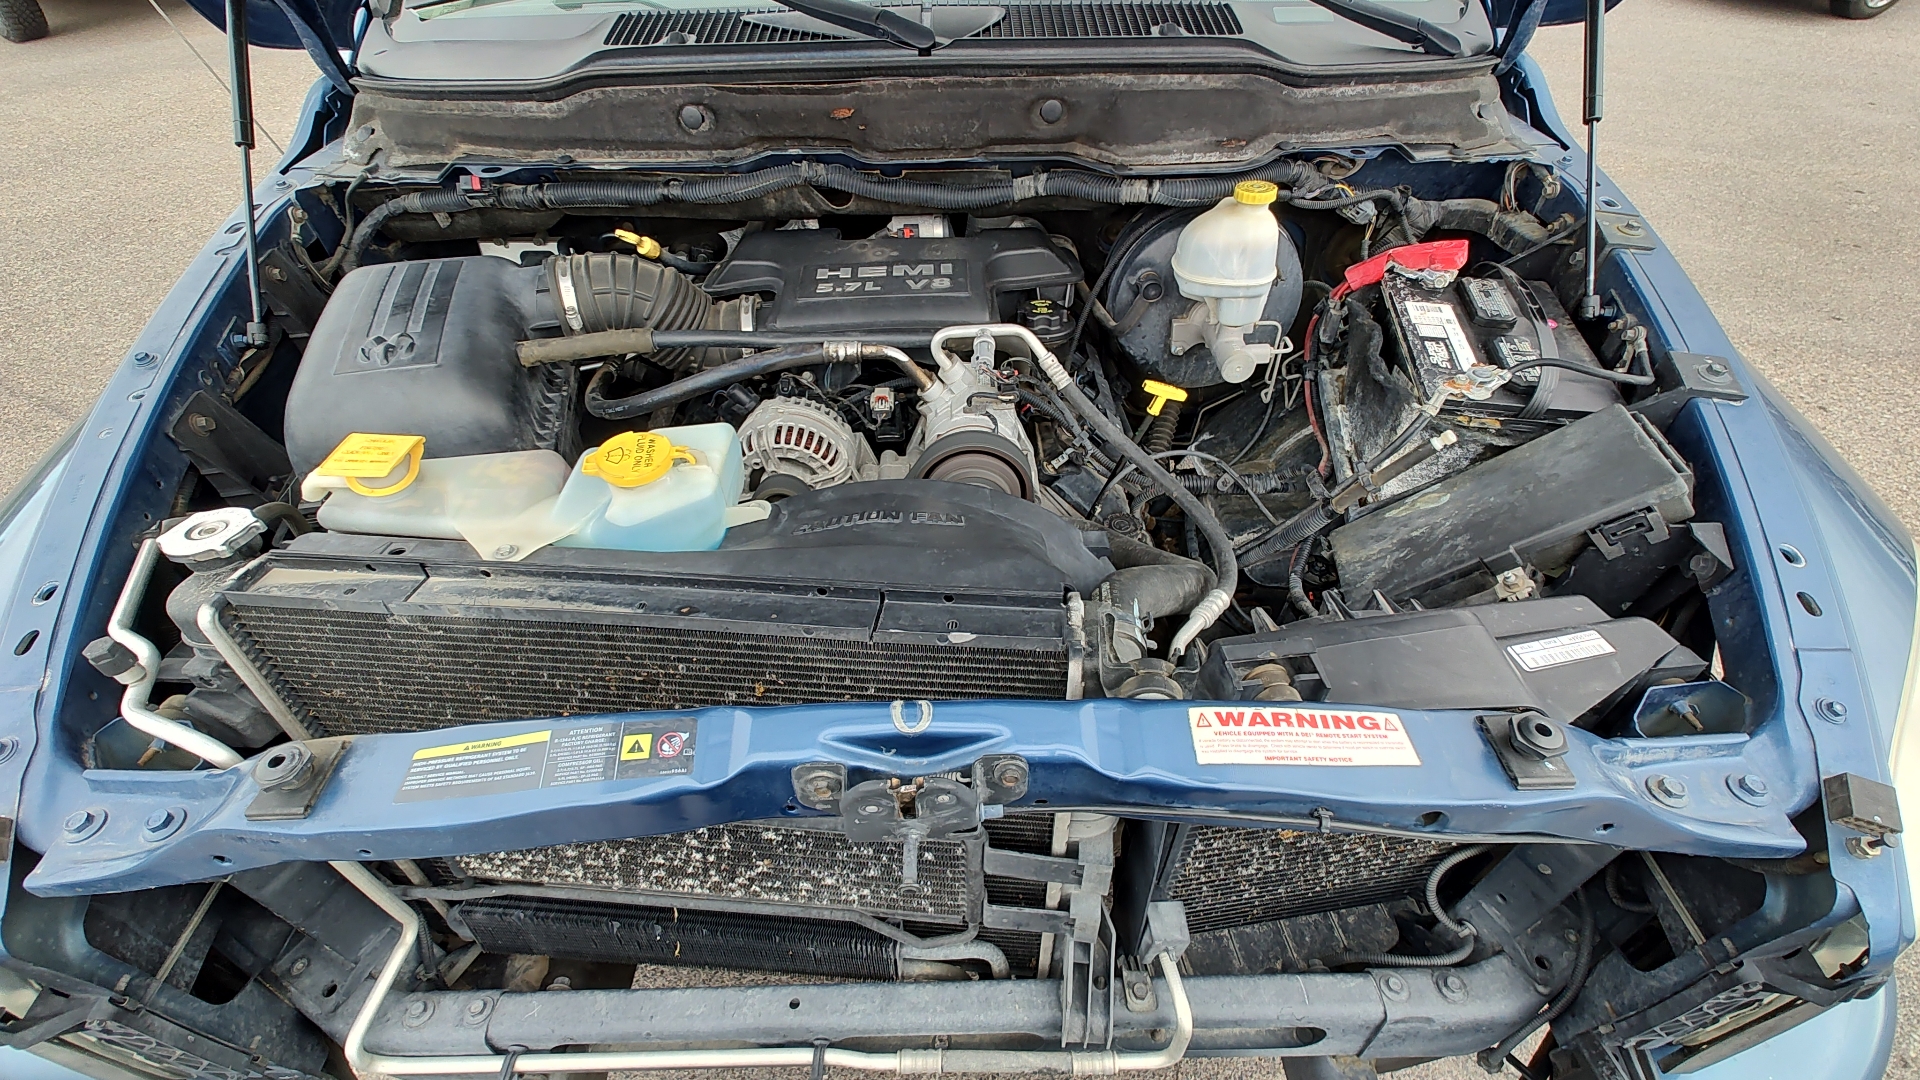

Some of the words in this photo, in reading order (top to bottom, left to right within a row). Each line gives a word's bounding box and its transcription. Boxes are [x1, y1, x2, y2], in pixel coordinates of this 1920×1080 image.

[816, 264, 952, 279] HEMI
[816, 282, 881, 293] 5.7L
[906, 278, 952, 290] V8
[644, 438, 656, 468] WASHER
[631, 454, 643, 473] ONLY
[910, 512, 966, 528] FAN
[1214, 712, 1381, 730] WARNING
[569, 726, 604, 736] ATTENTION
[471, 741, 502, 750] WARNING
[456, 752, 492, 762] REFRIGERANT
[444, 761, 472, 769] QUALIFIED
